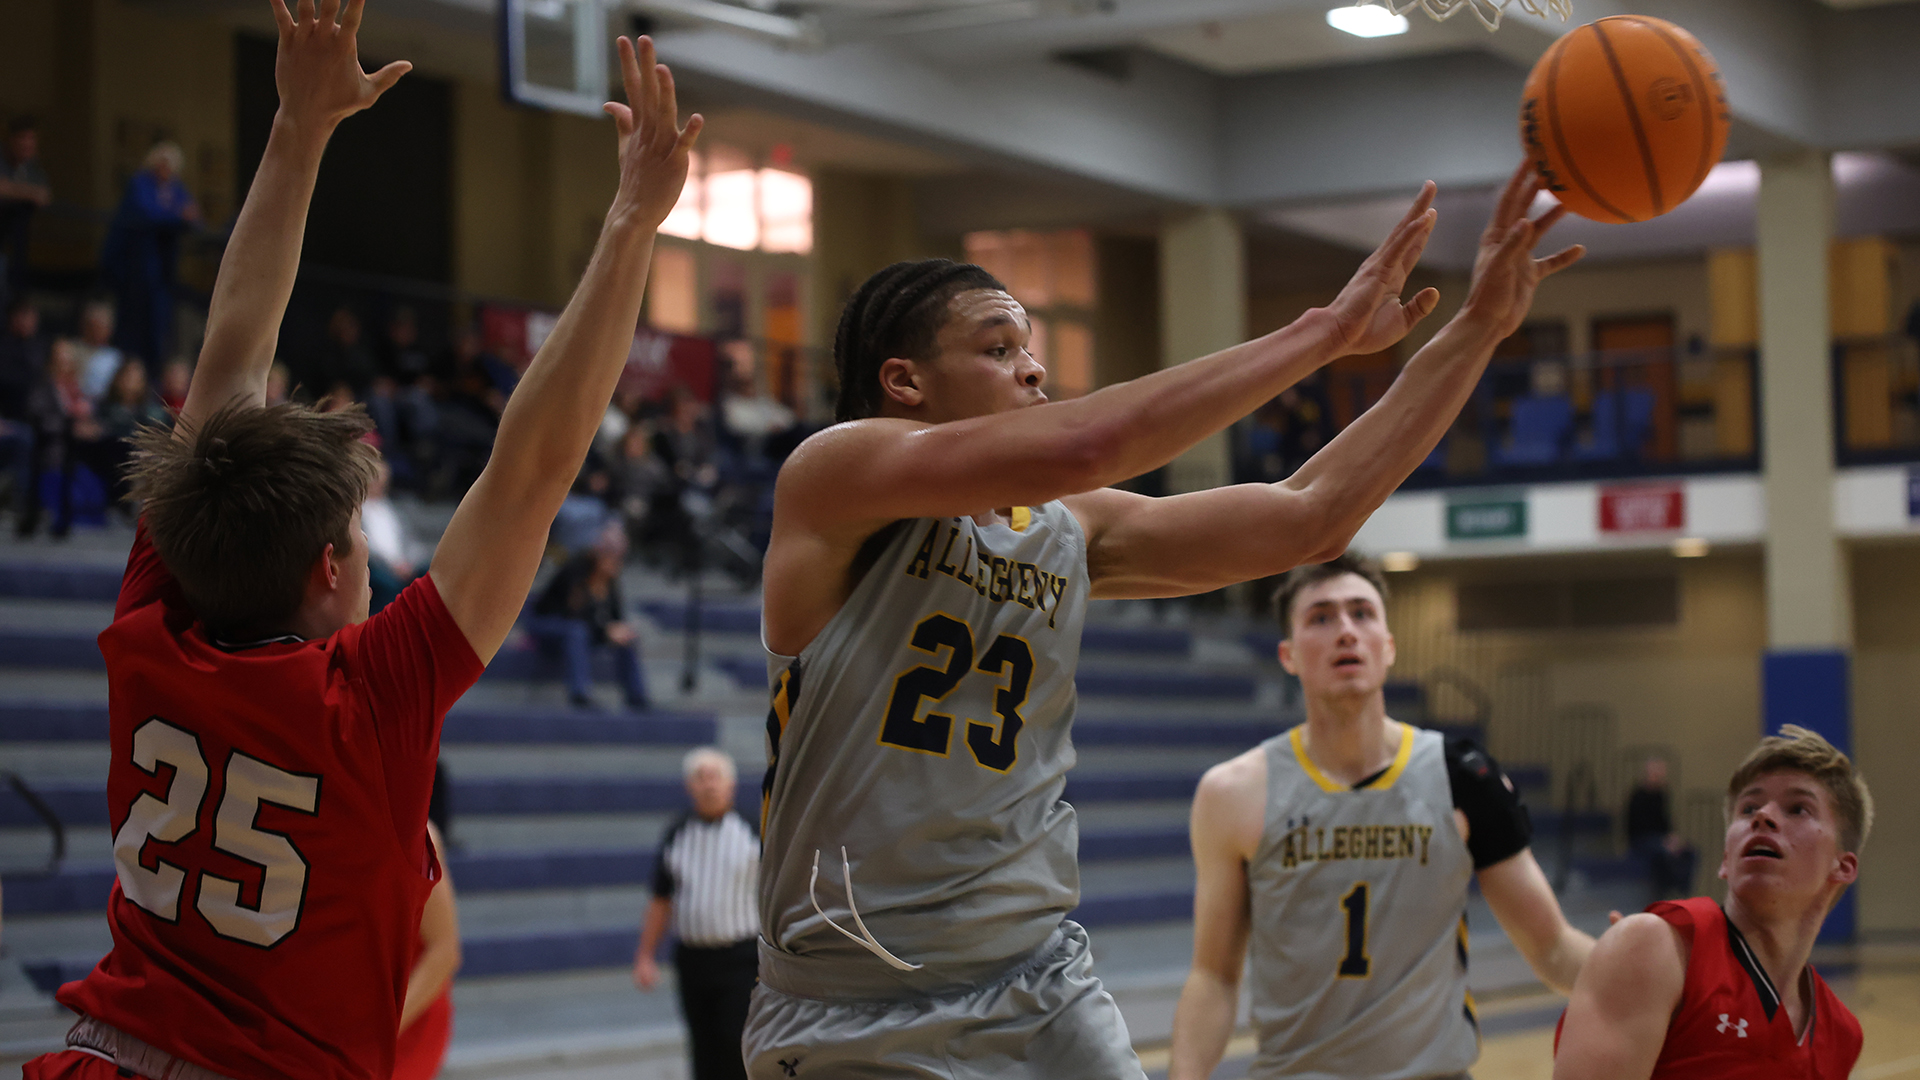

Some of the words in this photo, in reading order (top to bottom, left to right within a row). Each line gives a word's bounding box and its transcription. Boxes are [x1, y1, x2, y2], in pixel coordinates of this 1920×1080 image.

[876, 610, 1036, 775] 23
[112, 714, 324, 951] 25
[1282, 824, 1433, 868] ALLEGHENY
[1336, 881, 1372, 979] 1
